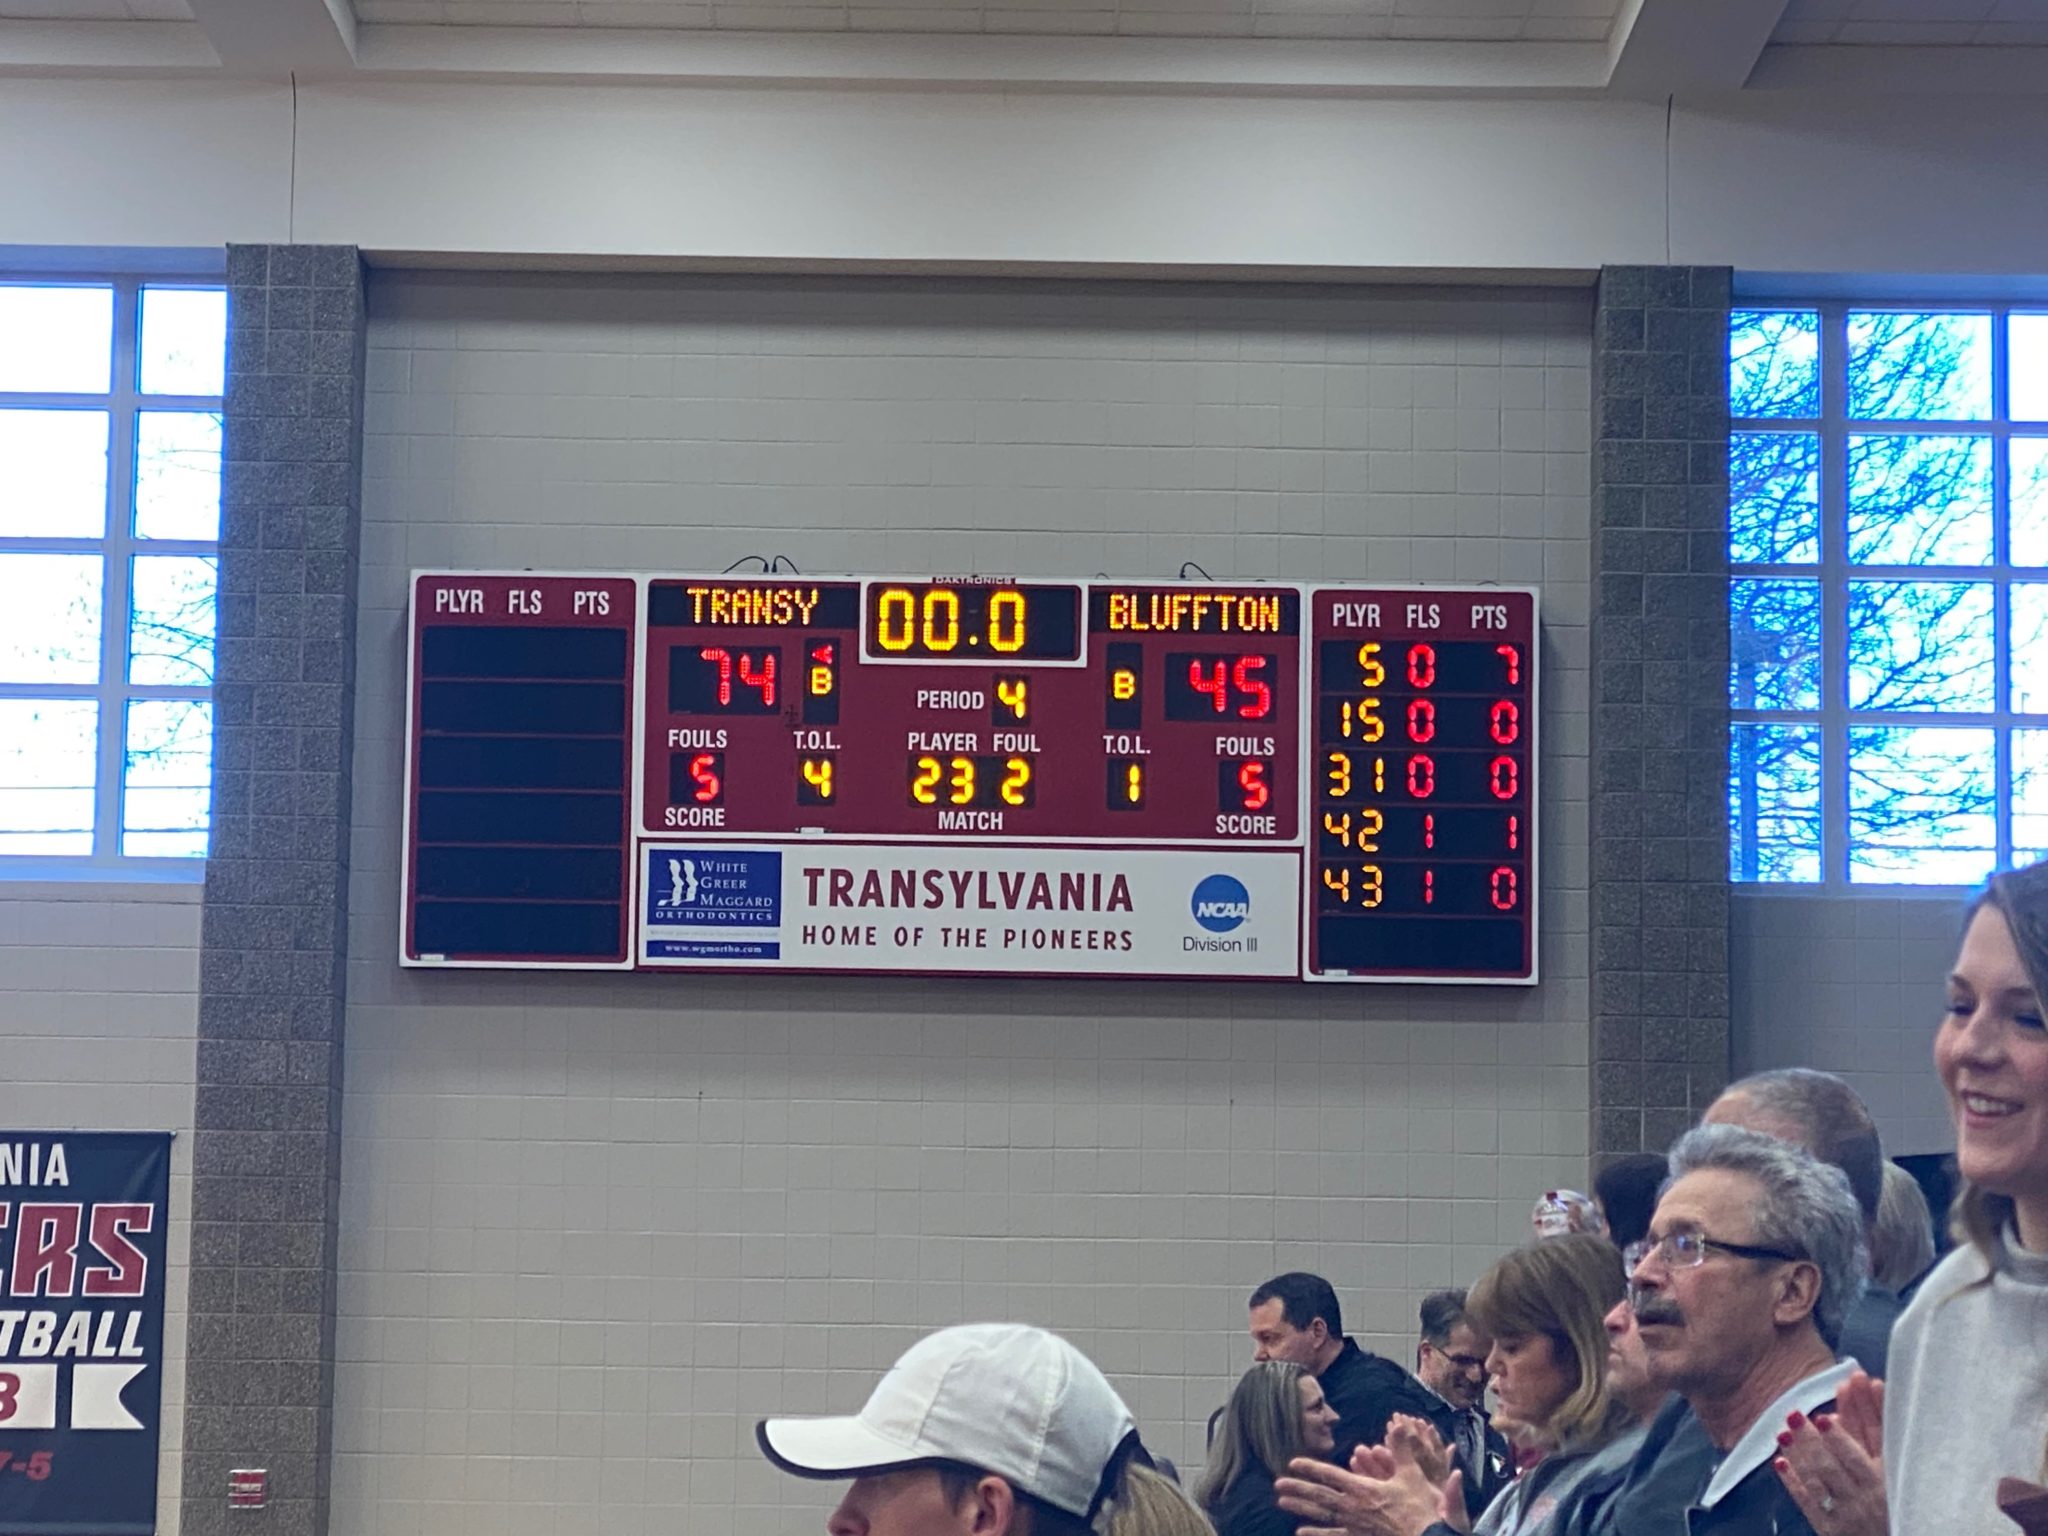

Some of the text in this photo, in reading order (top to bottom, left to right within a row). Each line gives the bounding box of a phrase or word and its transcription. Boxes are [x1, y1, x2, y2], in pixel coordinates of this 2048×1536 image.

[436, 589, 610, 616] PLYR FLS PTS
[686, 588, 819, 625] TRANSY
[878, 589, 1025, 652] 00.0
[1109, 593, 1280, 632] BLUFFTON
[1333, 604, 1507, 630] PLYR FLS PTS
[700, 649, 775, 706] 74
[811, 667, 832, 694] B
[1358, 643, 1518, 688] 5 0 7
[917, 690, 984, 708] PERIOD
[997, 680, 1025, 718] 4
[1114, 670, 1135, 699] B
[1189, 656, 1270, 718] 45
[668, 730, 727, 748] FOULS
[1342, 698, 1518, 744] 15 0 0
[793, 731, 841, 750] T.O.L.
[908, 733, 977, 752] PLAYER
[993, 734, 1041, 753] FOUL
[1103, 736, 1150, 754] T.O.L.
[1216, 737, 1274, 756] FOULS
[690, 754, 718, 800] 5
[804, 760, 831, 798] 4
[913, 757, 974, 804] 23
[1002, 758, 1030, 804] 2
[1129, 764, 1140, 802] 1
[1238, 762, 1268, 810] 5
[1329, 752, 1518, 799] 31 0 0
[665, 808, 725, 826] SCORE
[938, 812, 1003, 830] MATCH
[1216, 816, 1276, 834] SCORE
[1325, 810, 1517, 852] 42 1 1
[803, 868, 1133, 912] TRANSYLVANIA
[1325, 865, 1516, 910] 43 1 0
[656, 911, 772, 920] ORTHODONTICS
[1196, 902, 1248, 918] NCAA
[665, 945, 762, 954] www.wgmortho.com
[802, 925, 1132, 951] HOME OF THE PIONEERS
[1184, 936, 1258, 952] Division III
[0, 1143, 69, 1186] NIA
[0, 1202, 154, 1297] RS
[0, 1310, 144, 1357] TBALL
